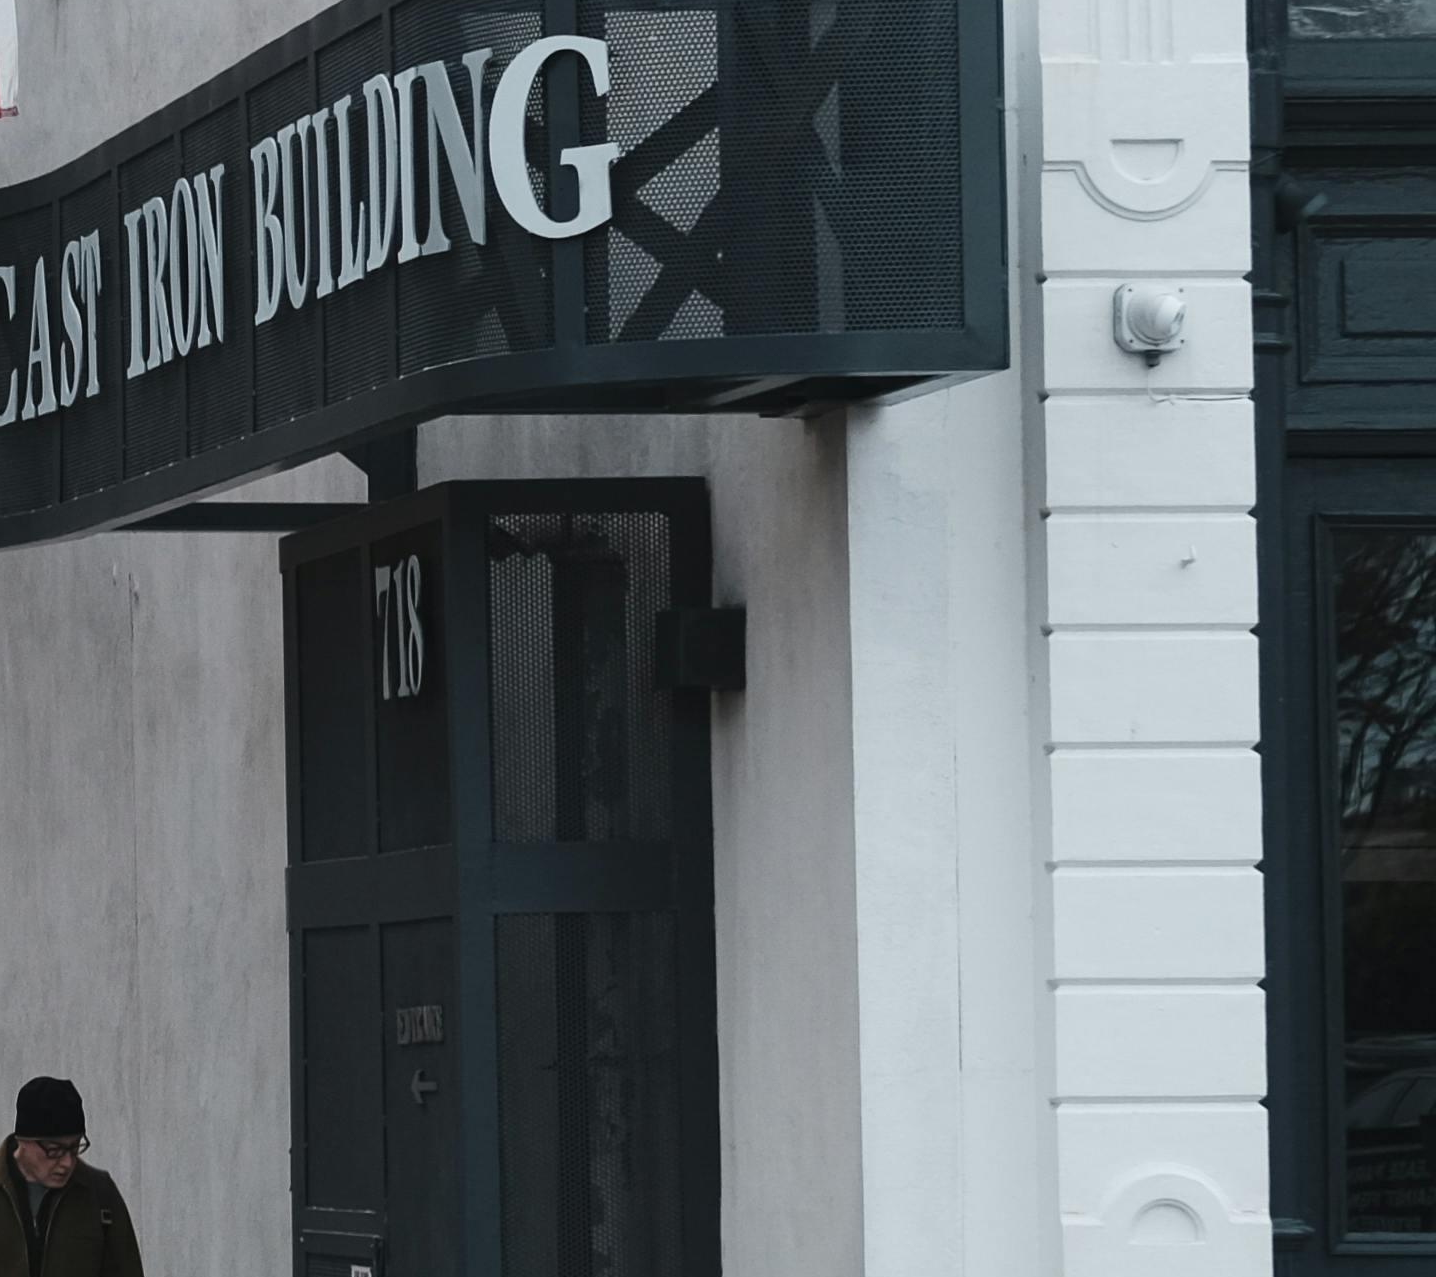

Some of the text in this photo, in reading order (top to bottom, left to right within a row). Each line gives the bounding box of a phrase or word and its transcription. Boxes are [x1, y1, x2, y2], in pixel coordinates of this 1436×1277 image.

[124, 163, 226, 378] IRON
[251, 34, 619, 326] BUILDING
[375, 554, 424, 700] 718
